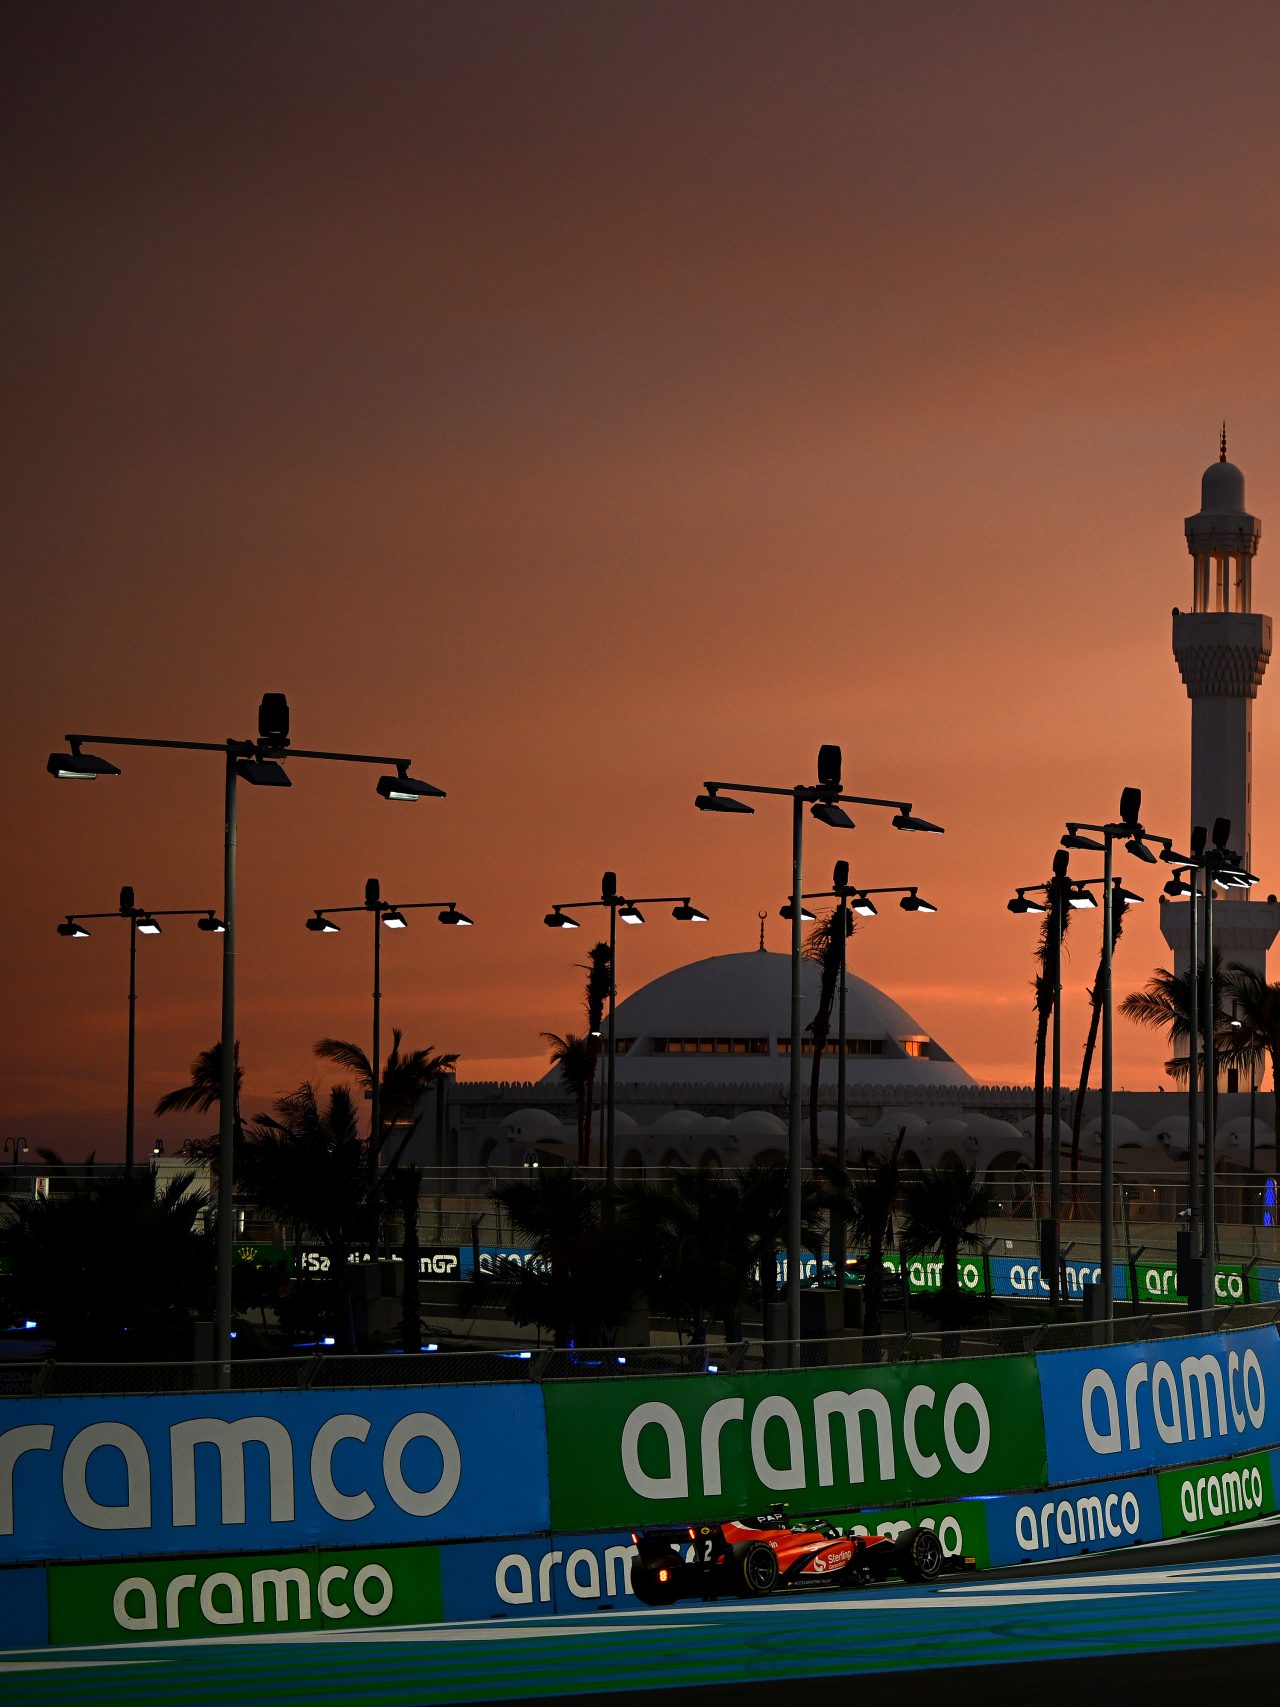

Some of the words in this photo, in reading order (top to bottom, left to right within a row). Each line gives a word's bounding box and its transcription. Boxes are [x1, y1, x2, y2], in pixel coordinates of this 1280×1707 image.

[1146, 1269, 1243, 1298] arco
[1082, 1348, 1265, 1455] aramco
[620, 1382, 991, 1499] aramco
[1015, 1491, 1140, 1551] aramco
[1180, 1465, 1263, 1522] aramco
[112, 1563, 394, 1631] aramco
[495, 1543, 697, 1605] aram
